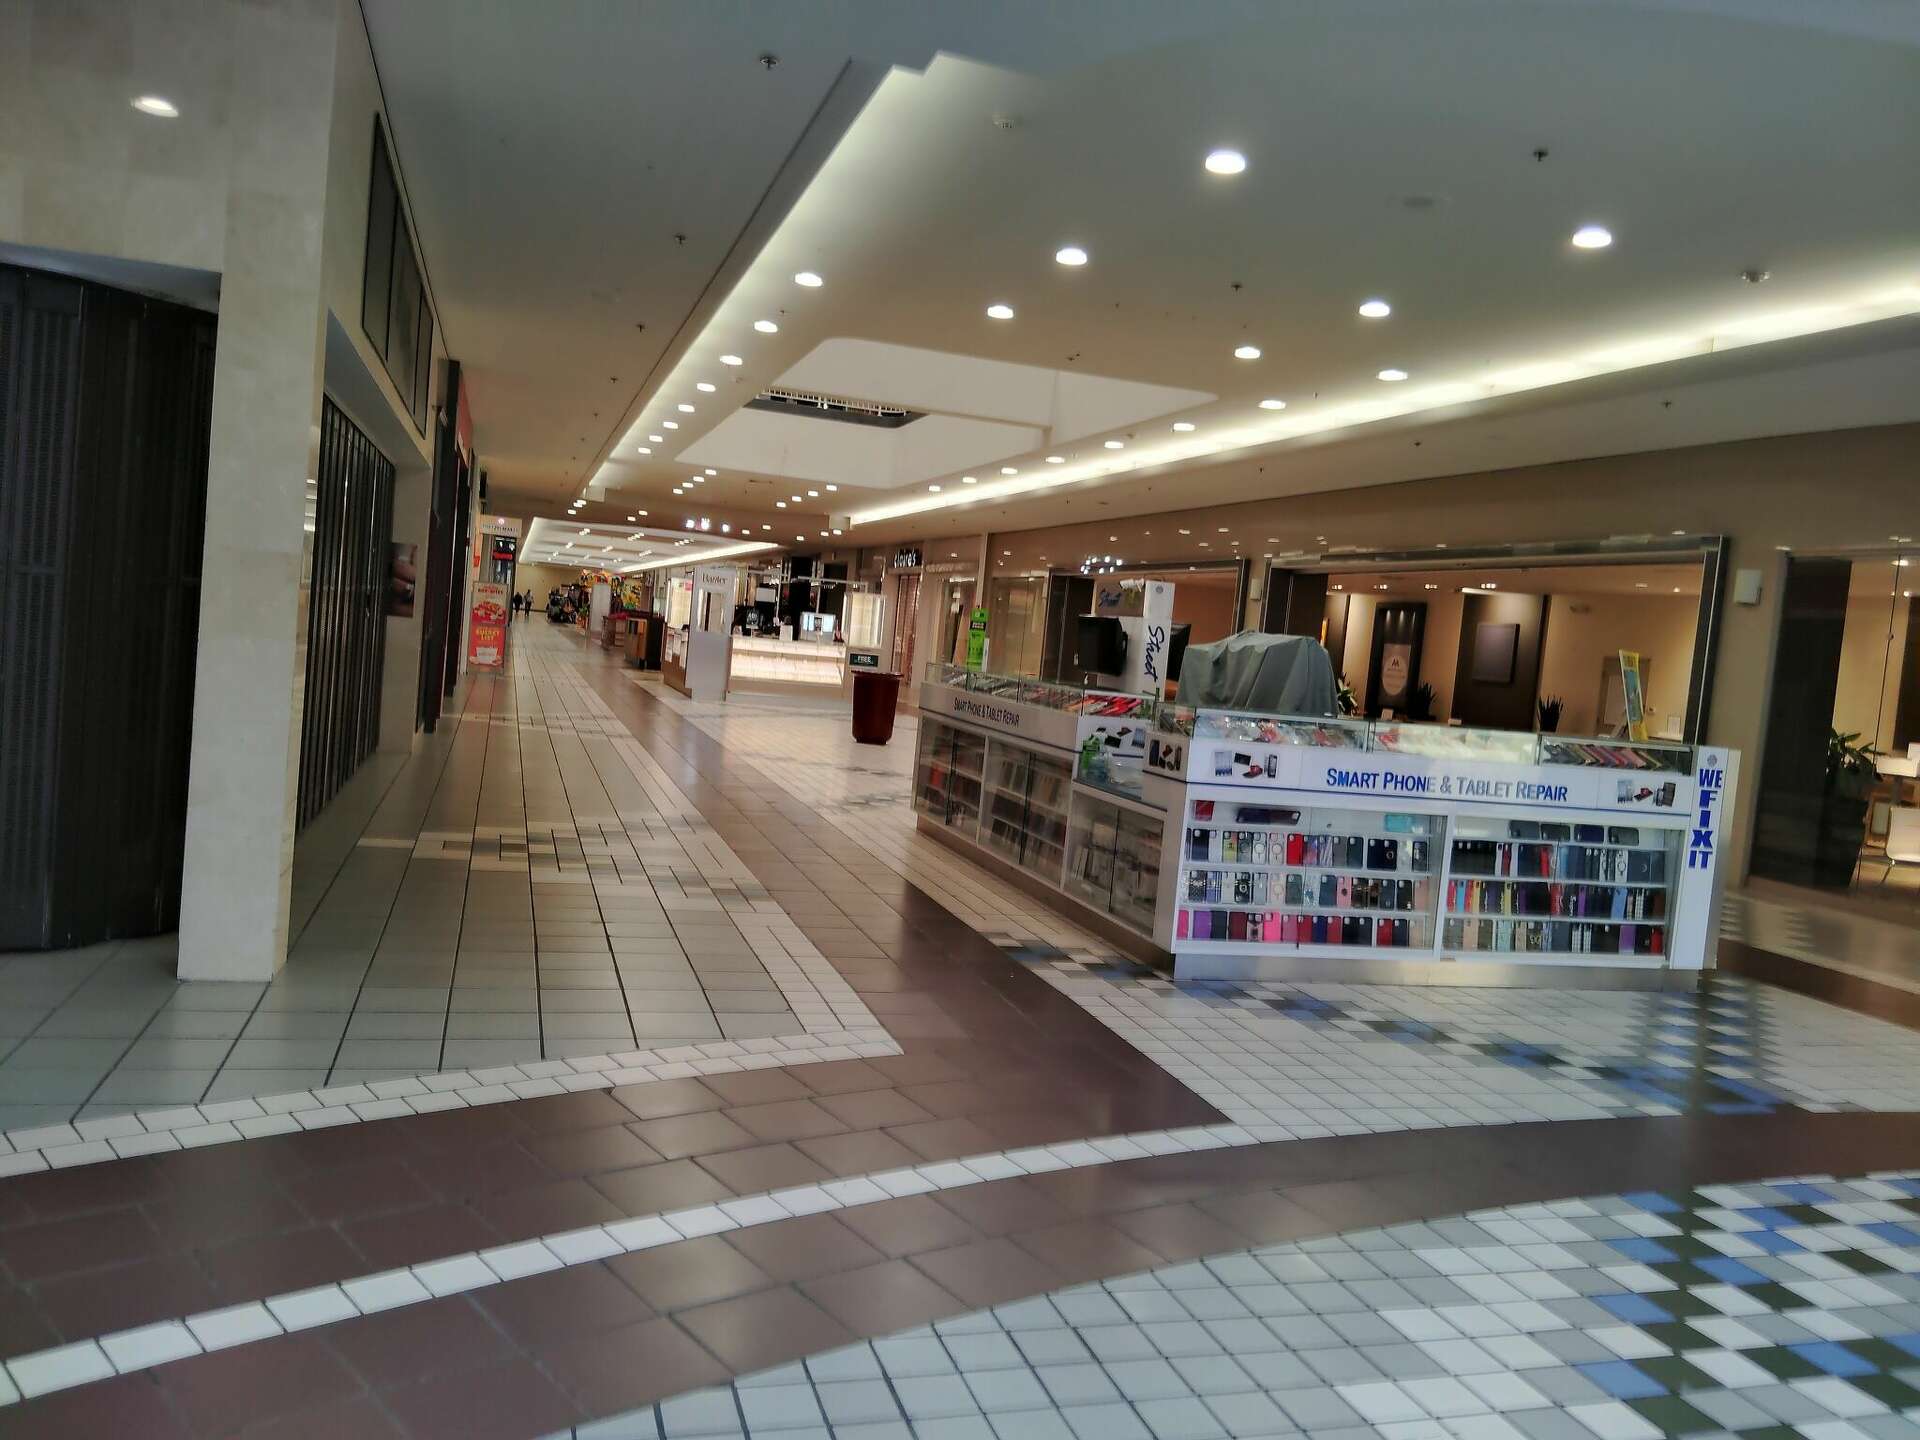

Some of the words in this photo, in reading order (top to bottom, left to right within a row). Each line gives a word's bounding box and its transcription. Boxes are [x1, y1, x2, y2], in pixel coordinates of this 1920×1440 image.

[1326, 768, 1379, 789] SMART
[1383, 772, 1436, 793] PHONE
[1439, 777, 1451, 793] &
[1456, 777, 1513, 798] TABLET
[1515, 781, 1568, 802] REPAIR
[1700, 768, 1722, 788] WE
[1689, 850, 1713, 868] IT
